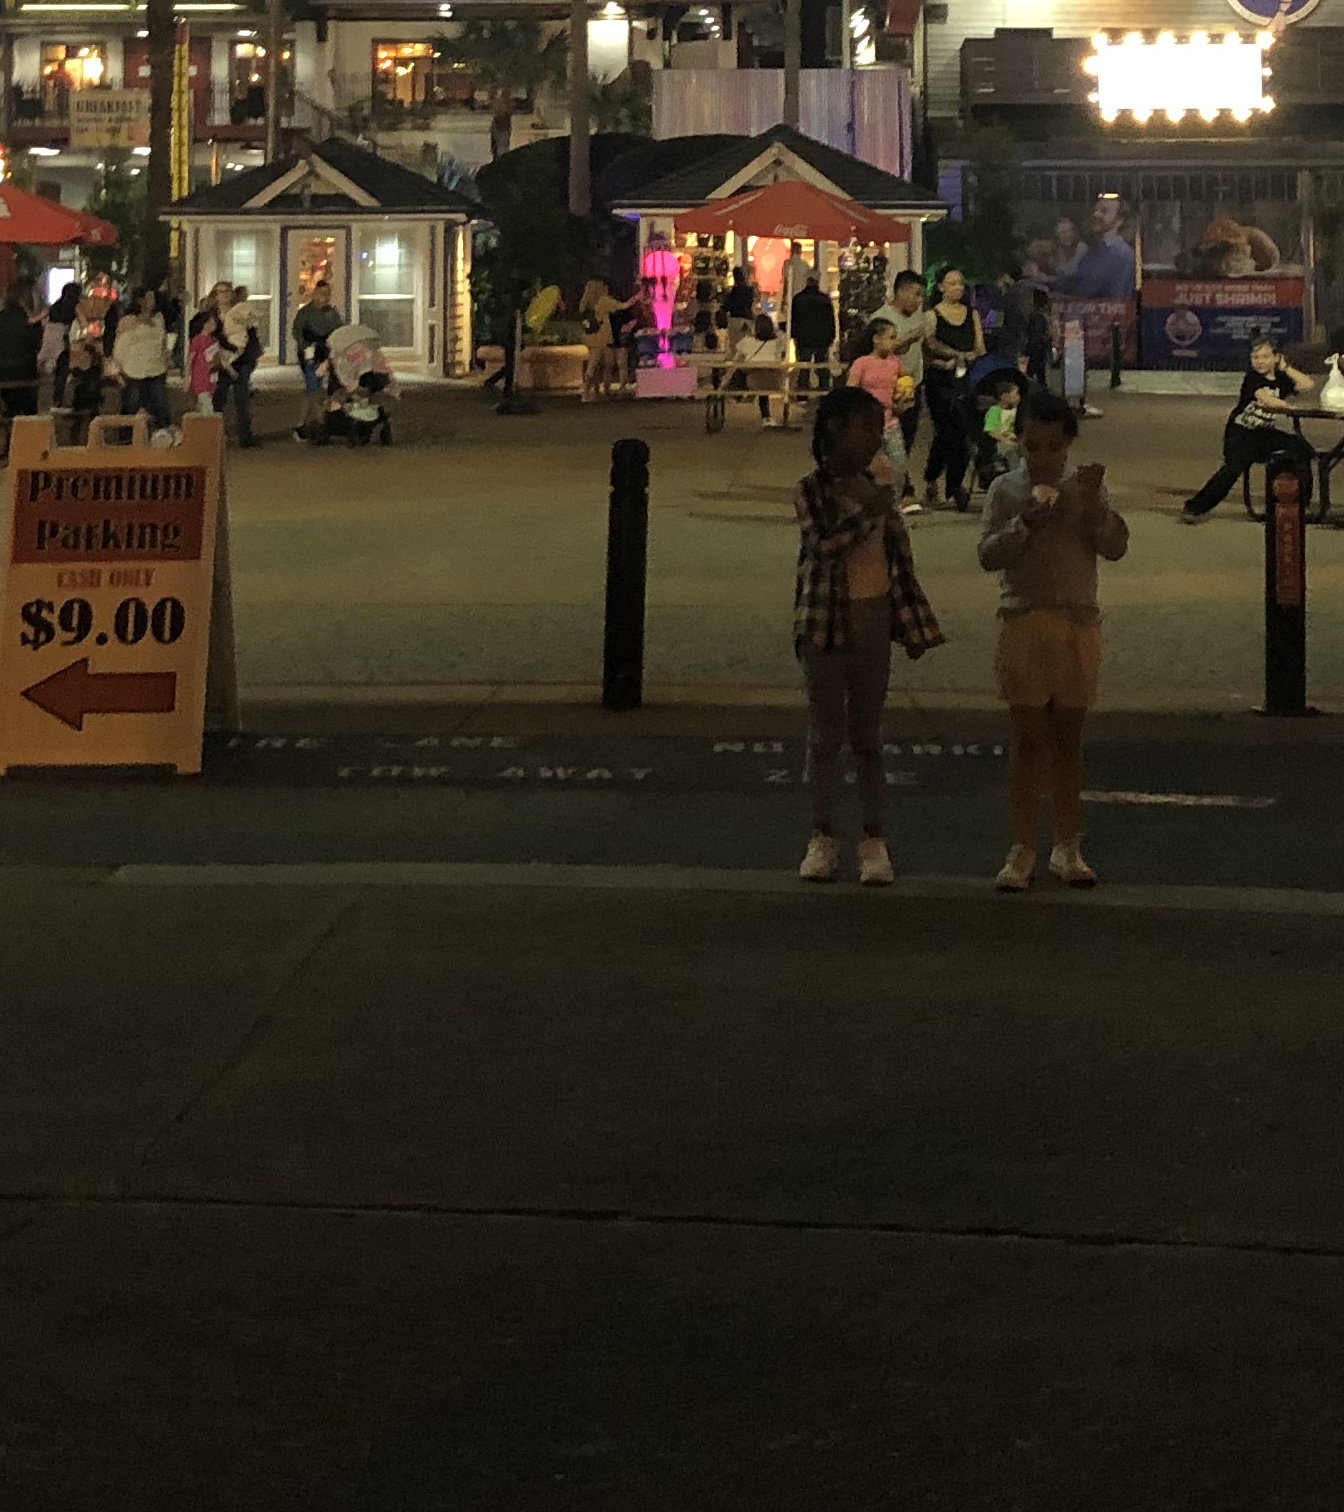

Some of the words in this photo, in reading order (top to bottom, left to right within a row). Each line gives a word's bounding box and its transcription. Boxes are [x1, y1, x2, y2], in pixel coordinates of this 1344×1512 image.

[28, 470, 194, 502] Premium
[34, 519, 183, 553] Parking
[19, 596, 186, 651] $9.00
